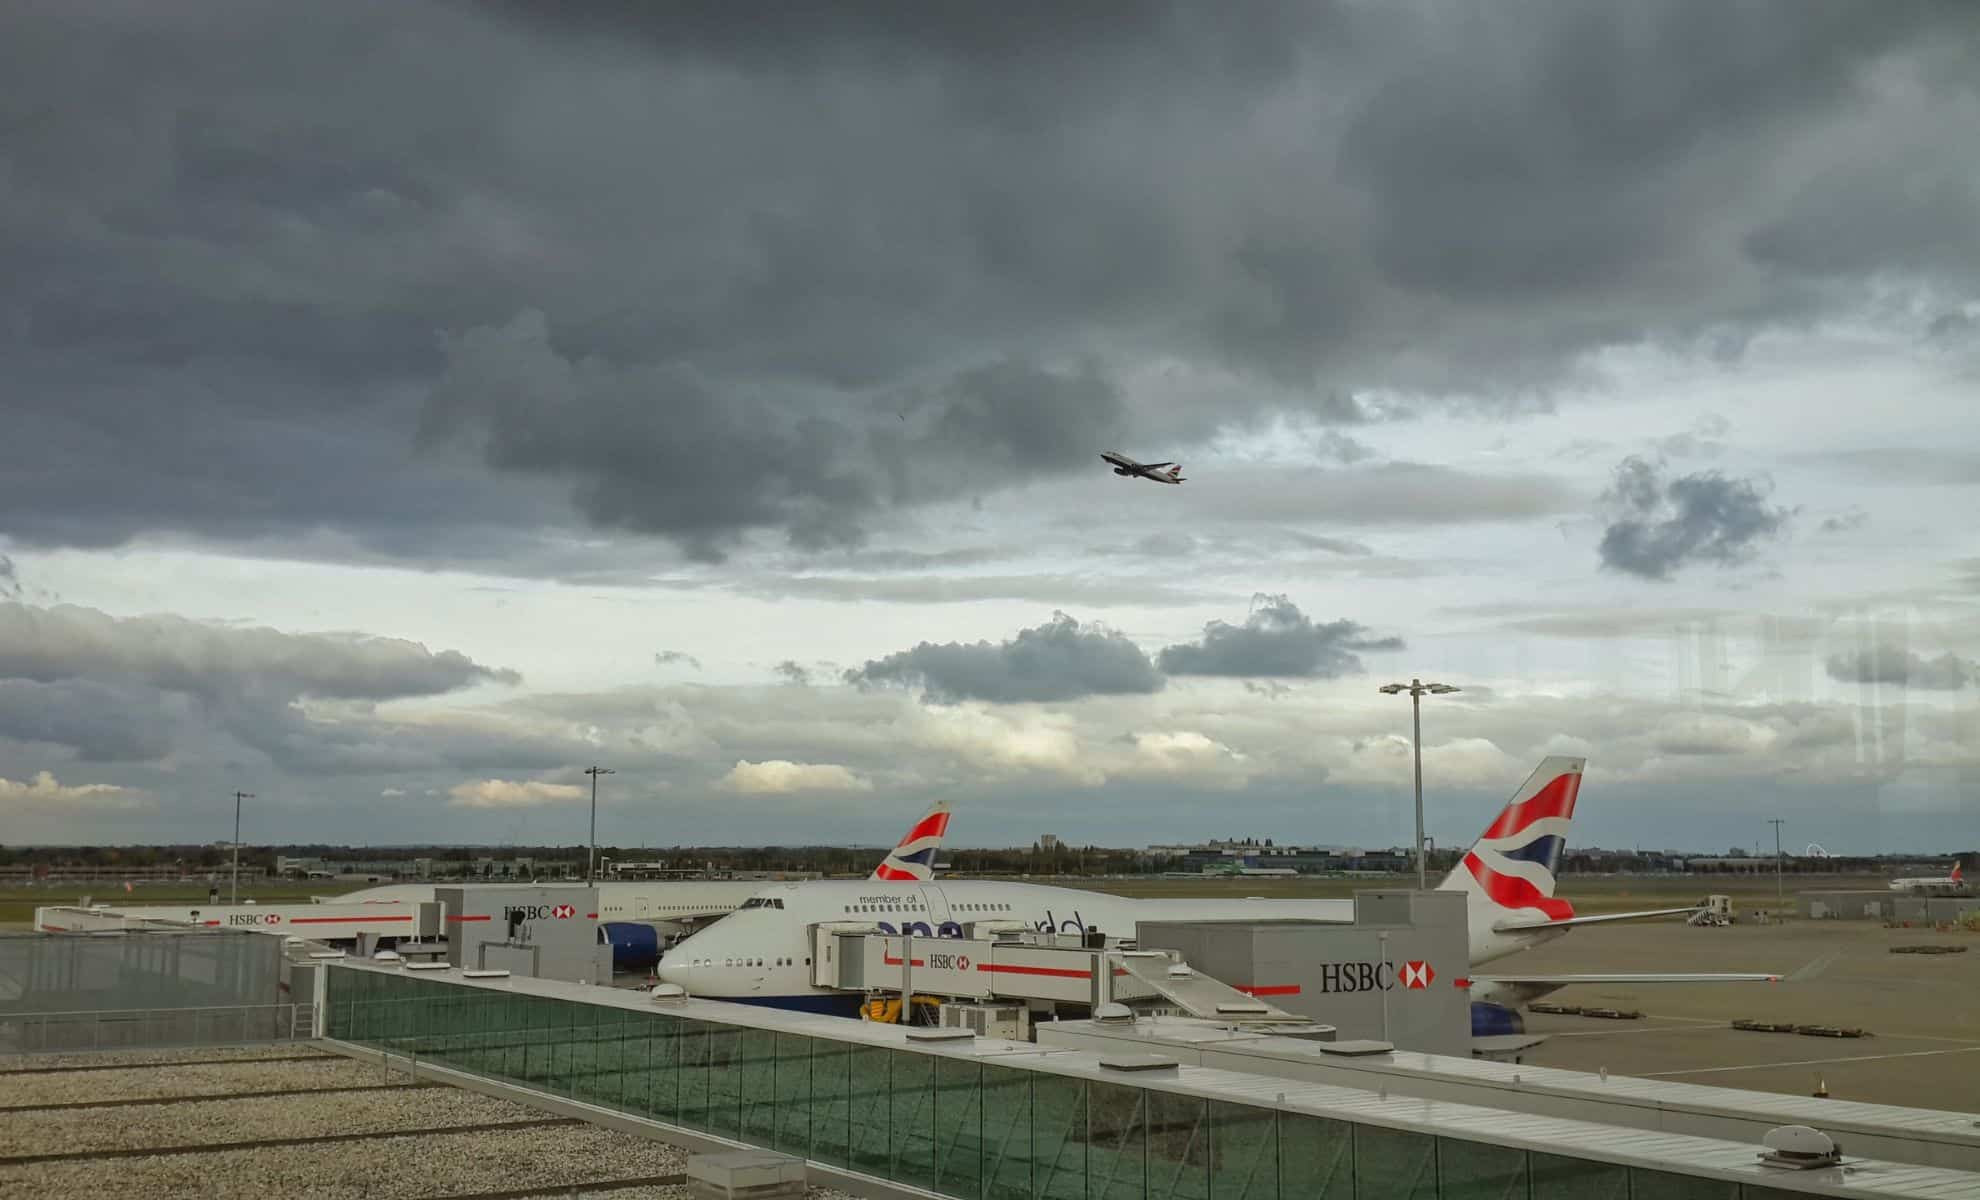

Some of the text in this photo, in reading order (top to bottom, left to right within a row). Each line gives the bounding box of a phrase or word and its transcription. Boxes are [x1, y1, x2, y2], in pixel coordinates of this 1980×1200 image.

[860, 894, 917, 904] member of
[229, 914, 264, 926] HSBC
[930, 953, 956, 970] HSBC
[1320, 961, 1394, 993] HSBC
